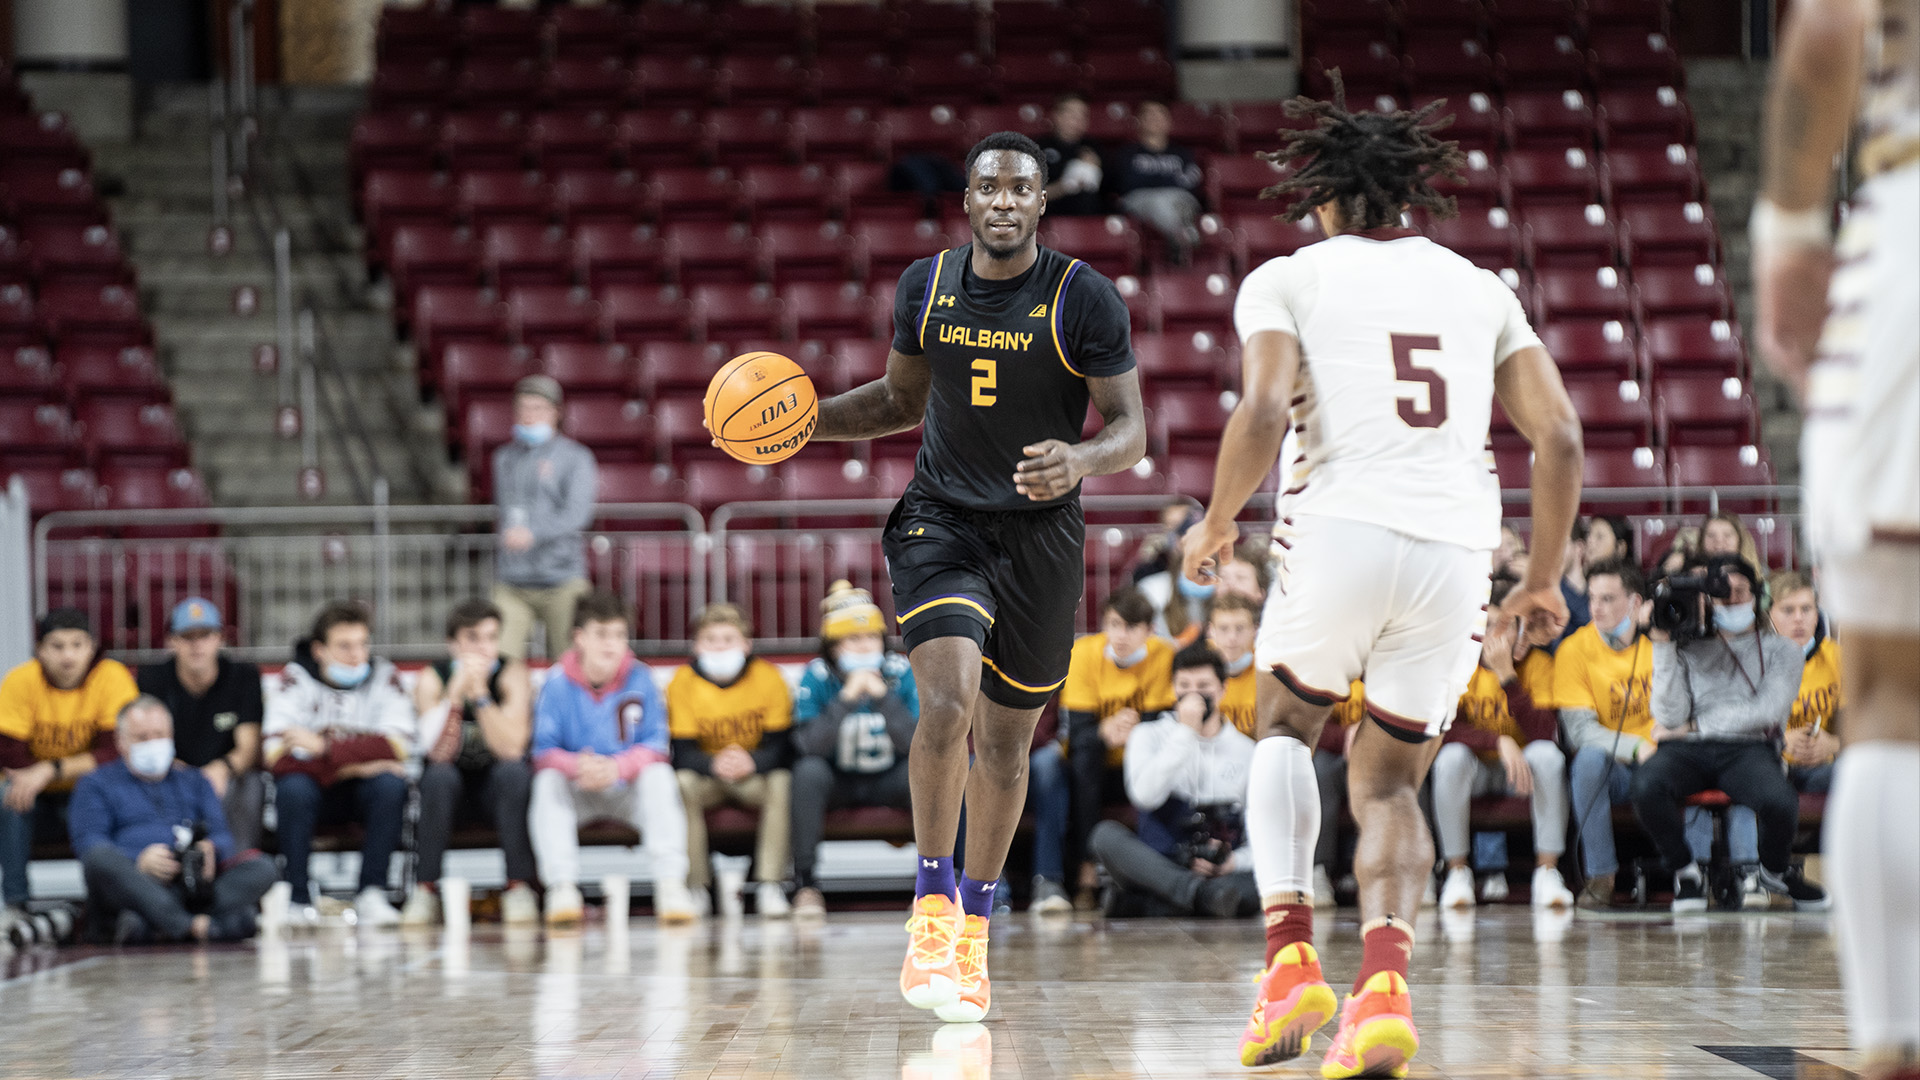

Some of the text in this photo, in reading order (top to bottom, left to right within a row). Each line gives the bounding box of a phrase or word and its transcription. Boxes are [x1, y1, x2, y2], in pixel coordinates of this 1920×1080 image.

[939, 323, 1033, 352] UALBANY
[971, 358, 997, 407] 2
[1388, 331, 1448, 429] 5
[755, 415, 817, 455] Wilson
